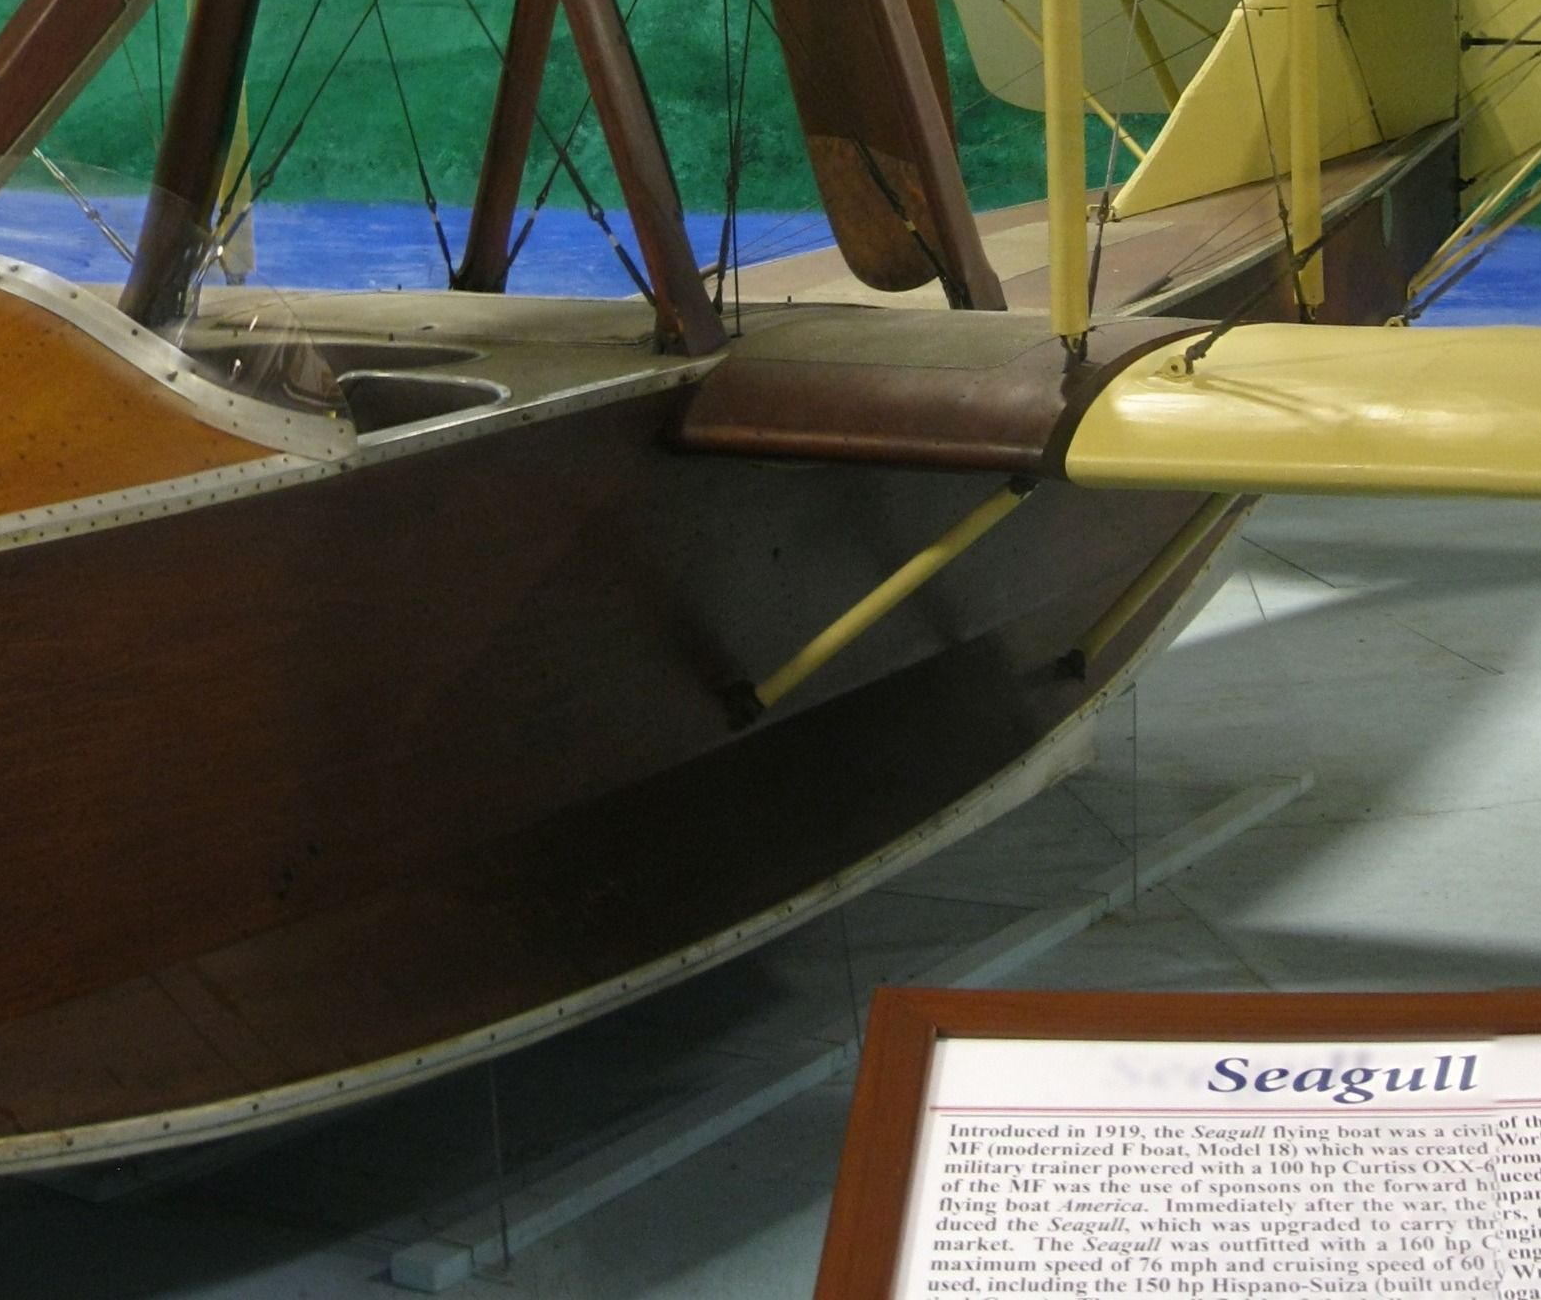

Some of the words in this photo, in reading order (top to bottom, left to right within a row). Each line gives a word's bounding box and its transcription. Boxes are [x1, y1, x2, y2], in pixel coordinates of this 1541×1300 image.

[1207, 1055, 1478, 1104] Seagull
[1498, 1116, 1519, 1128] of
[949, 1124, 1061, 1137] Introduced
[1066, 1125, 1086, 1138] in
[1094, 1125, 1146, 1139] 1919,
[1152, 1125, 1185, 1138] the
[1190, 1125, 1267, 1142] Seagull
[1272, 1125, 1330, 1142] flying
[1336, 1125, 1383, 1138] boat
[1387, 1128, 1427, 1138] was
[1432, 1128, 1446, 1137] a
[946, 1142, 984, 1155] MF
[986, 1143, 1116, 1158] (modernized
[1120, 1143, 1136, 1156] F
[1138, 1143, 1191, 1158] boat,
[1195, 1141, 1262, 1156] Model
[1266, 1140, 1299, 1157] 18)
[1303, 1141, 1366, 1156] which
[1371, 1146, 1410, 1156] was
[1413, 1142, 1490, 1155] created
[943, 1160, 1025, 1177] military
[1030, 1161, 1103, 1174] trainer
[1106, 1161, 1195, 1178] powered
[1200, 1161, 1246, 1174] with
[1250, 1165, 1264, 1174] a
[1269, 1161, 1305, 1174] 100
[1309, 1161, 1337, 1178] hp
[1341, 1160, 1419, 1174] Curtiss
[941, 1179, 961, 1192] of
[968, 1179, 1000, 1193] the
[1009, 1179, 1043, 1193] MF
[1053, 1183, 1091, 1193] was
[1099, 1177, 1130, 1193] the
[1139, 1183, 1172, 1193] use
[1180, 1179, 1201, 1193] of
[1208, 1183, 1301, 1197] sponsons
[1309, 1183, 1334, 1193] on
[1343, 1179, 1375, 1193] the
[1383, 1178, 1468, 1192] forward
[938, 1197, 997, 1216] flying
[1004, 1198, 1051, 1212] boat
[1058, 1198, 1149, 1212] America.
[1165, 1196, 1296, 1216] Immediately
[1304, 1198, 1356, 1212] after
[1360, 1198, 1394, 1212] the
[1402, 1201, 1448, 1213] war,
[1454, 1197, 1488, 1211] the
[935, 1215, 998, 1231] duced
[1006, 1217, 1039, 1231] the
[1047, 1217, 1129, 1236] Seagull,
[1140, 1218, 1202, 1232] which
[1211, 1222, 1251, 1232] was
[1260, 1215, 1362, 1236] upgraded
[1369, 1219, 1391, 1231] to
[1399, 1220, 1457, 1235] carry
[932, 1237, 1014, 1251] market.
[1033, 1237, 1075, 1251] The
[1081, 1235, 1163, 1255] Seagull
[1169, 1241, 1211, 1252] was
[1218, 1235, 1311, 1252] outfitted
[1319, 1237, 1367, 1252] with
[1375, 1241, 1390, 1251] a
[1398, 1236, 1436, 1251] 160
[1443, 1236, 1474, 1256] hp
[930, 1257, 1037, 1271] maximum
[1043, 1257, 1104, 1276] speed
[1110, 1257, 1133, 1272] of
[1138, 1257, 1164, 1272] 76
[1170, 1257, 1219, 1276] mph
[1224, 1257, 1266, 1272] and
[1272, 1257, 1359, 1276] cruising
[1366, 1257, 1426, 1276] speed
[1432, 1255, 1454, 1271] of
[1459, 1255, 1486, 1271] 60
[926, 1277, 981, 1293] used,
[986, 1277, 1088, 1296] including
[1093, 1277, 1128, 1292] the
[1134, 1277, 1172, 1292] 150
[1176, 1278, 1205, 1297] hp
[1210, 1277, 1369, 1297] Hispano-Suiza
[1373, 1276, 1433, 1296] (built
